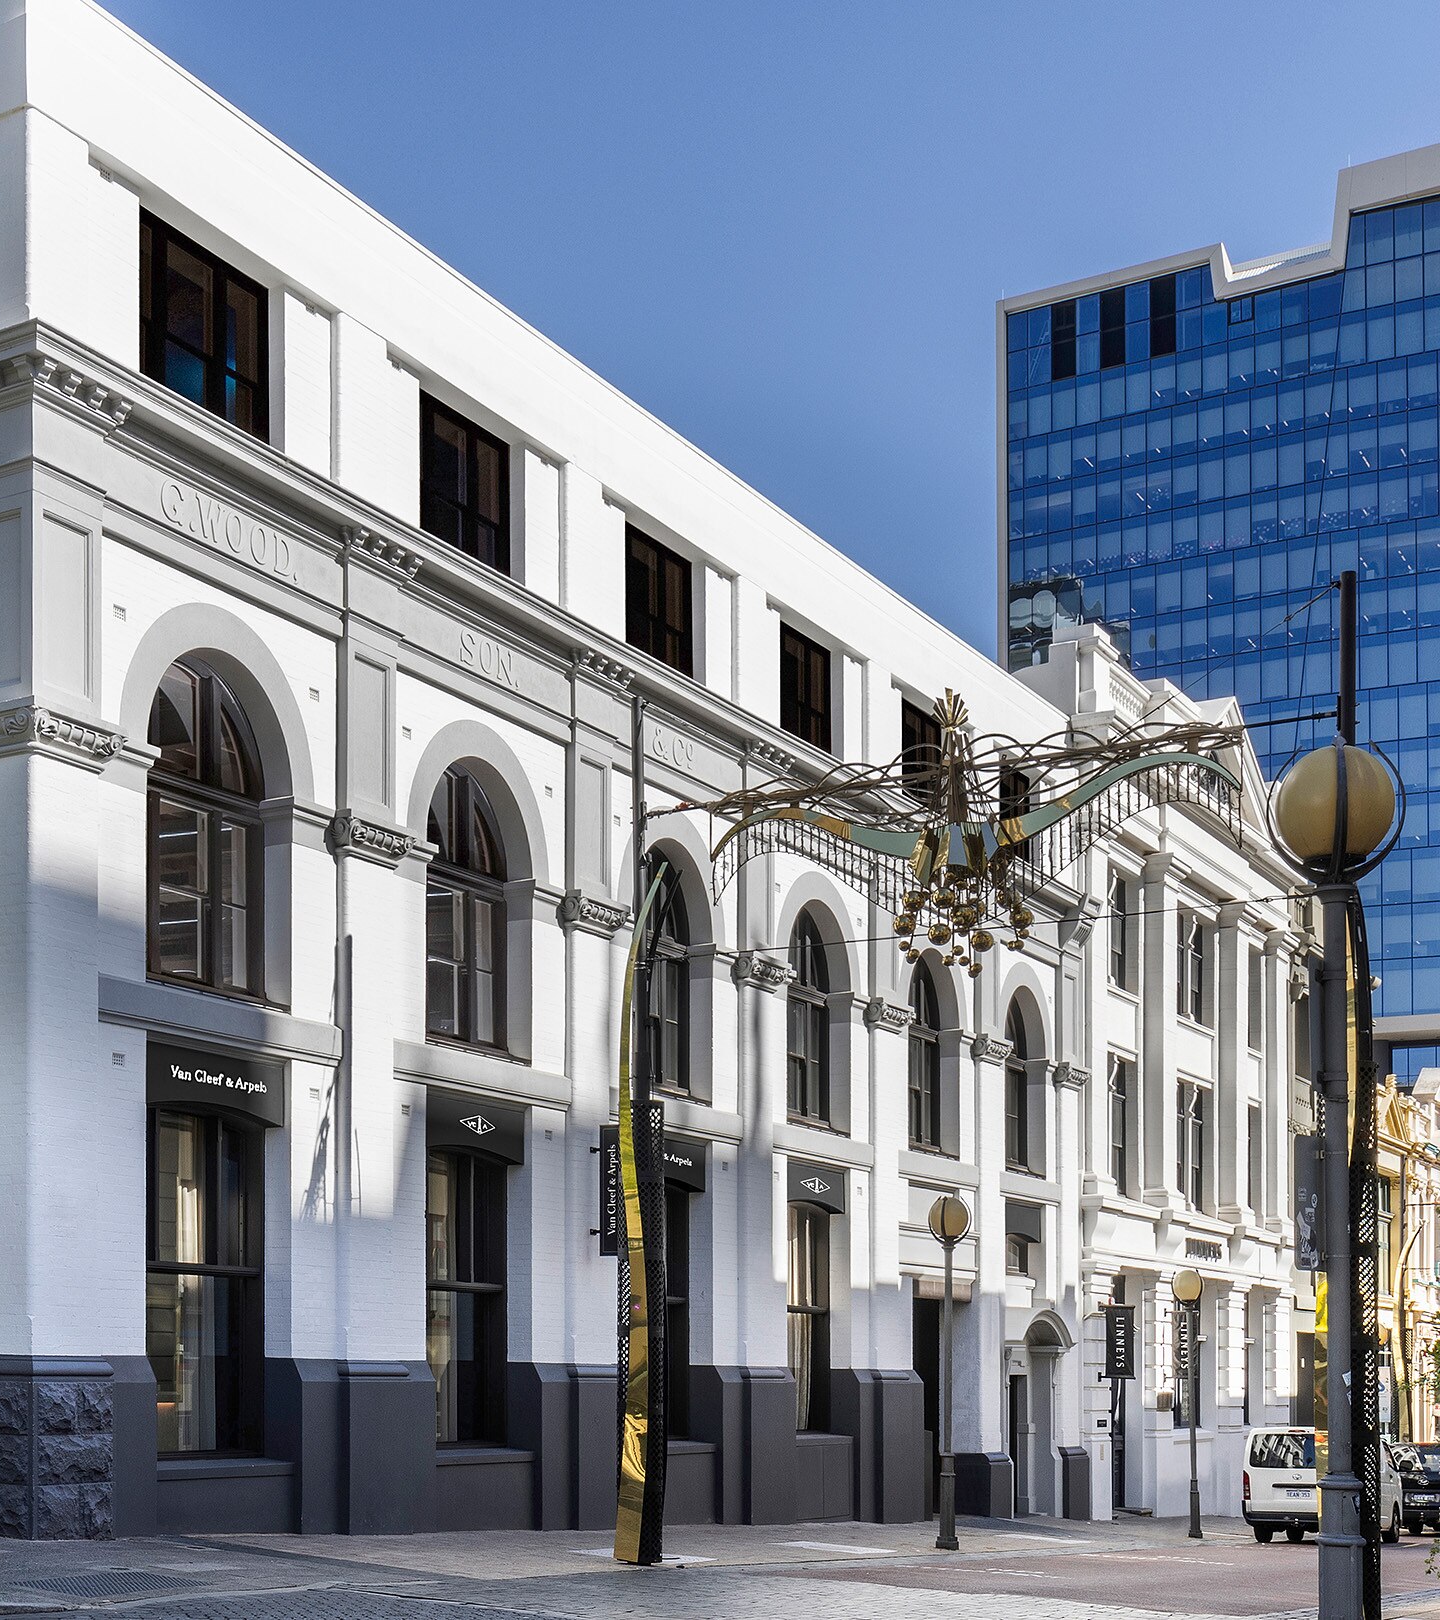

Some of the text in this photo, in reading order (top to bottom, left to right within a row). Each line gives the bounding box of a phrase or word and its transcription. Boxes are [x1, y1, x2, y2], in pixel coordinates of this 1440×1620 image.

[652, 725, 668, 761] &
[170, 1064, 268, 1094] Van Cleef & Arpels
[607, 1144, 619, 1236] Van Cleef & Arpels
[1115, 1316, 1125, 1369] LINNEYS
